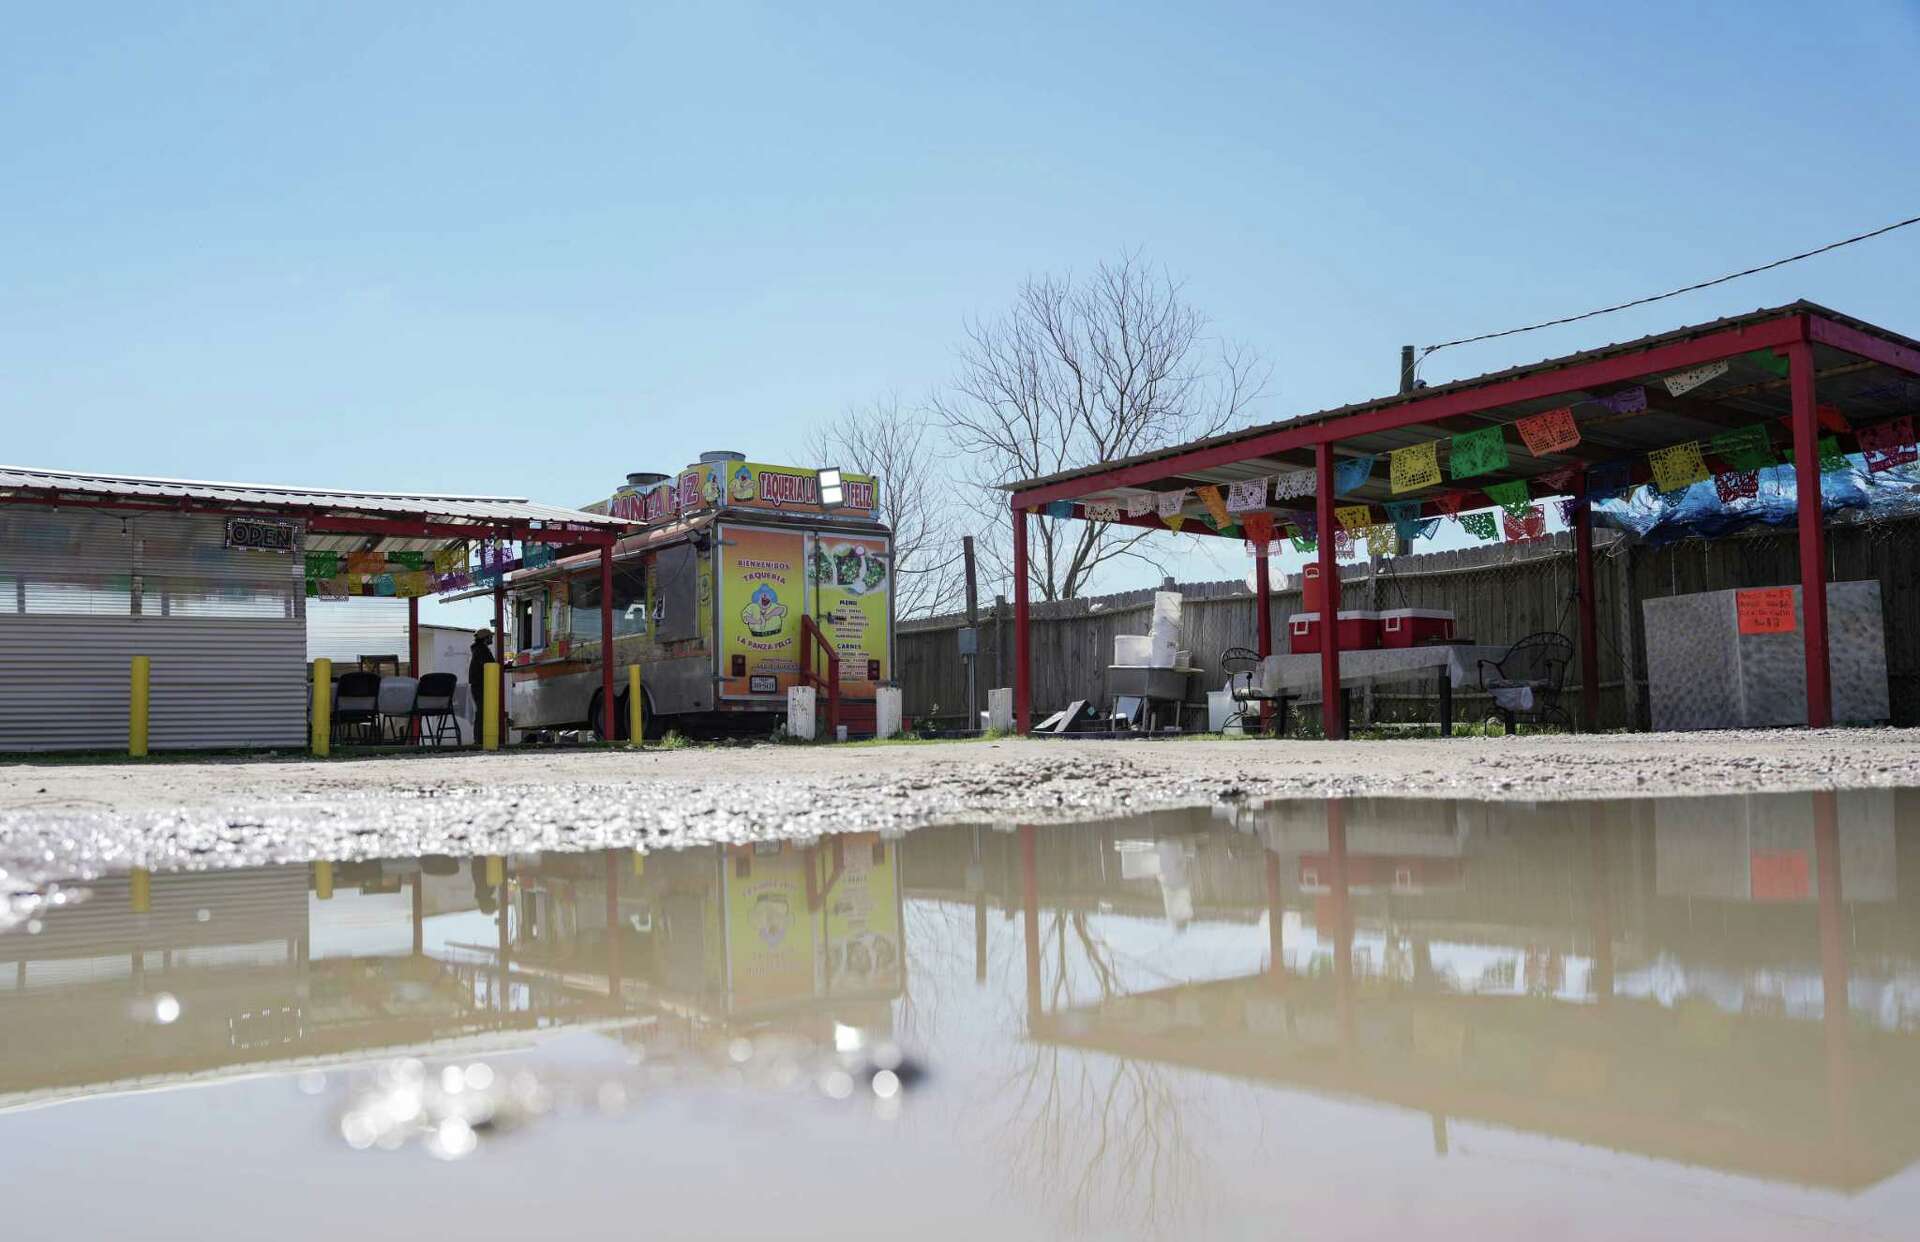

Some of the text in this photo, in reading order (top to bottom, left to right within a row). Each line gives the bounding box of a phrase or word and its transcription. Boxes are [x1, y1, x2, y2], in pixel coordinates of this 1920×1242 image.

[760, 472, 804, 506] TAQUERIA
[804, 477, 818, 504] LA
[849, 480, 874, 509] FELIZ
[231, 525, 289, 548] OPEN
[737, 559, 790, 570] BIENVENIDOS
[743, 571, 786, 585] TAQUERIA
[736, 635, 792, 650] LA PANZA FELIZ
